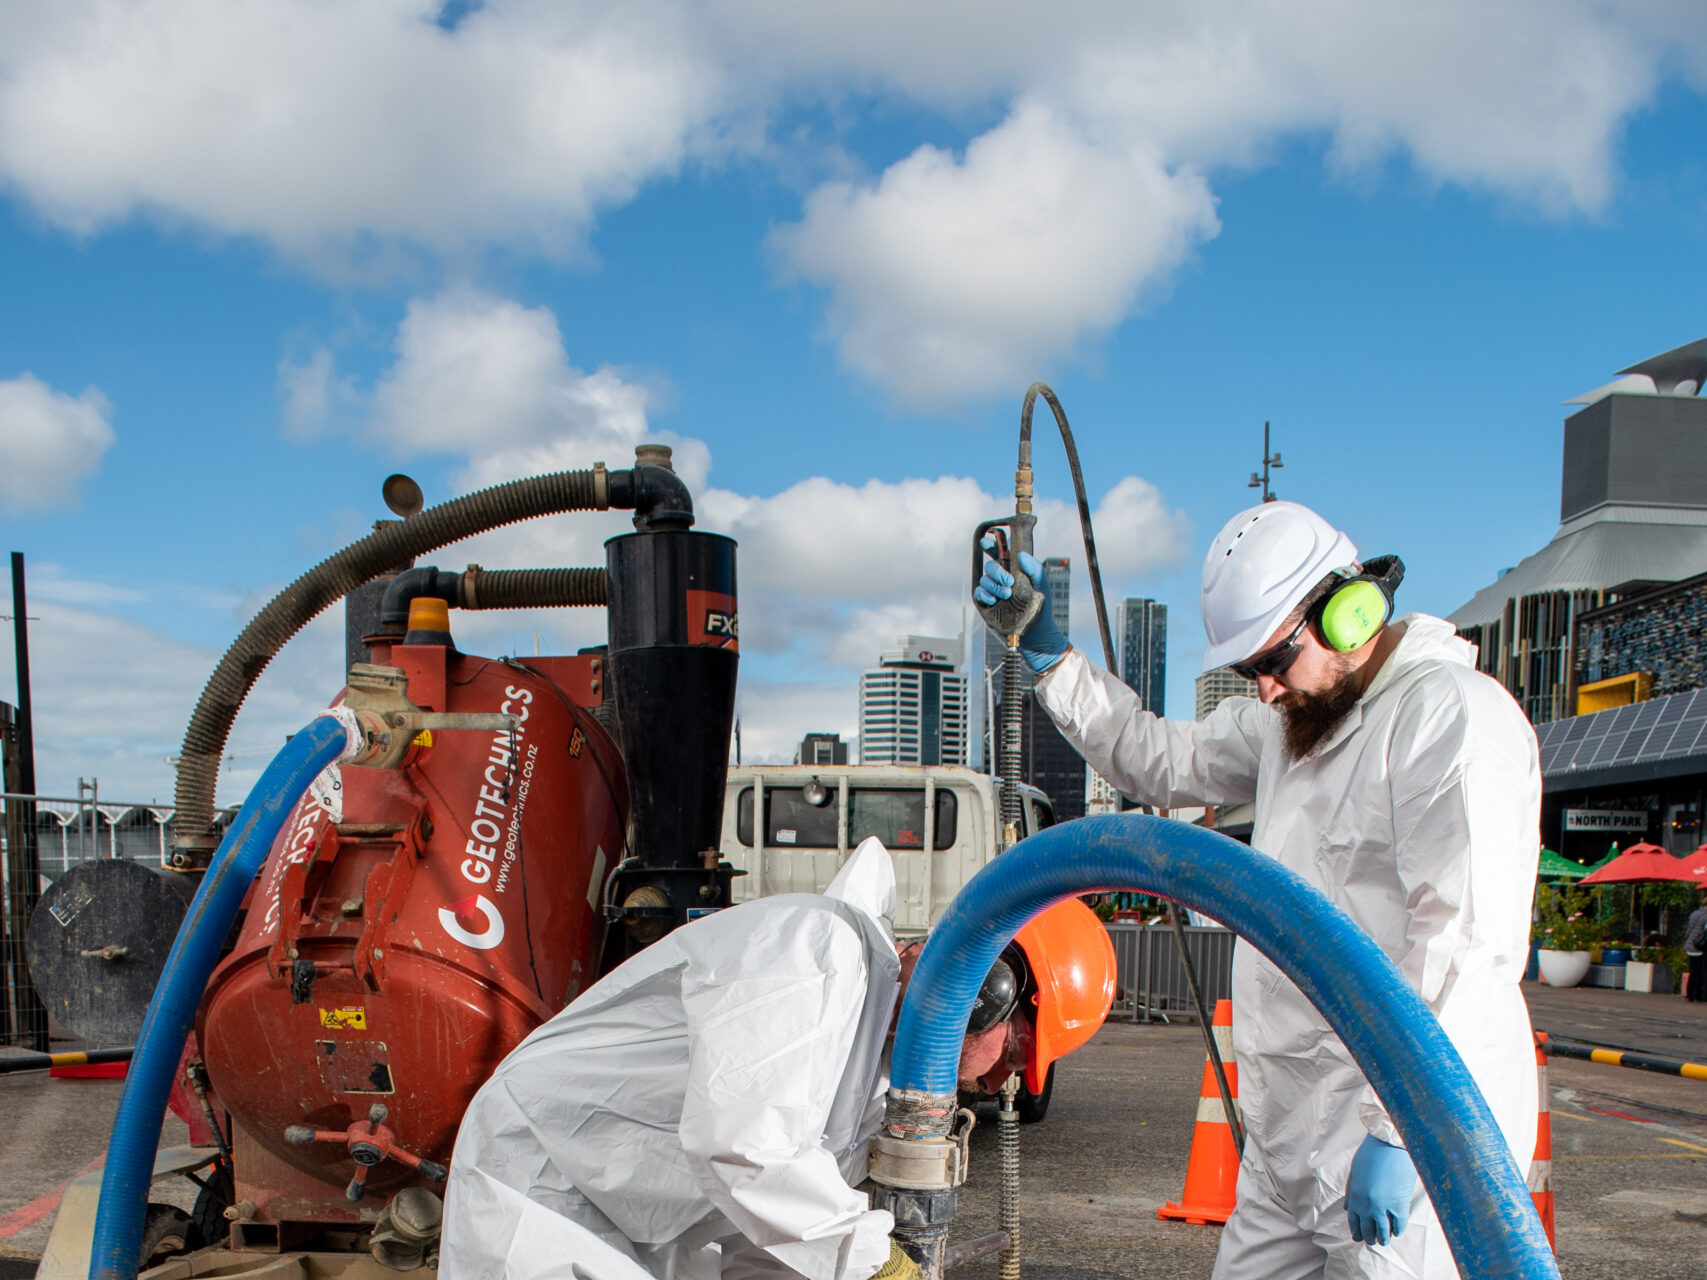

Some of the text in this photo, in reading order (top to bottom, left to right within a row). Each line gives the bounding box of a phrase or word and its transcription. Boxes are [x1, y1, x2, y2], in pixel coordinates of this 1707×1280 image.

[569, 727, 583, 757] 150
[461, 685, 533, 884] GEOTECHNCS
[1575, 816, 1610, 826] NORTH
[1614, 816, 1642, 827] PARK
